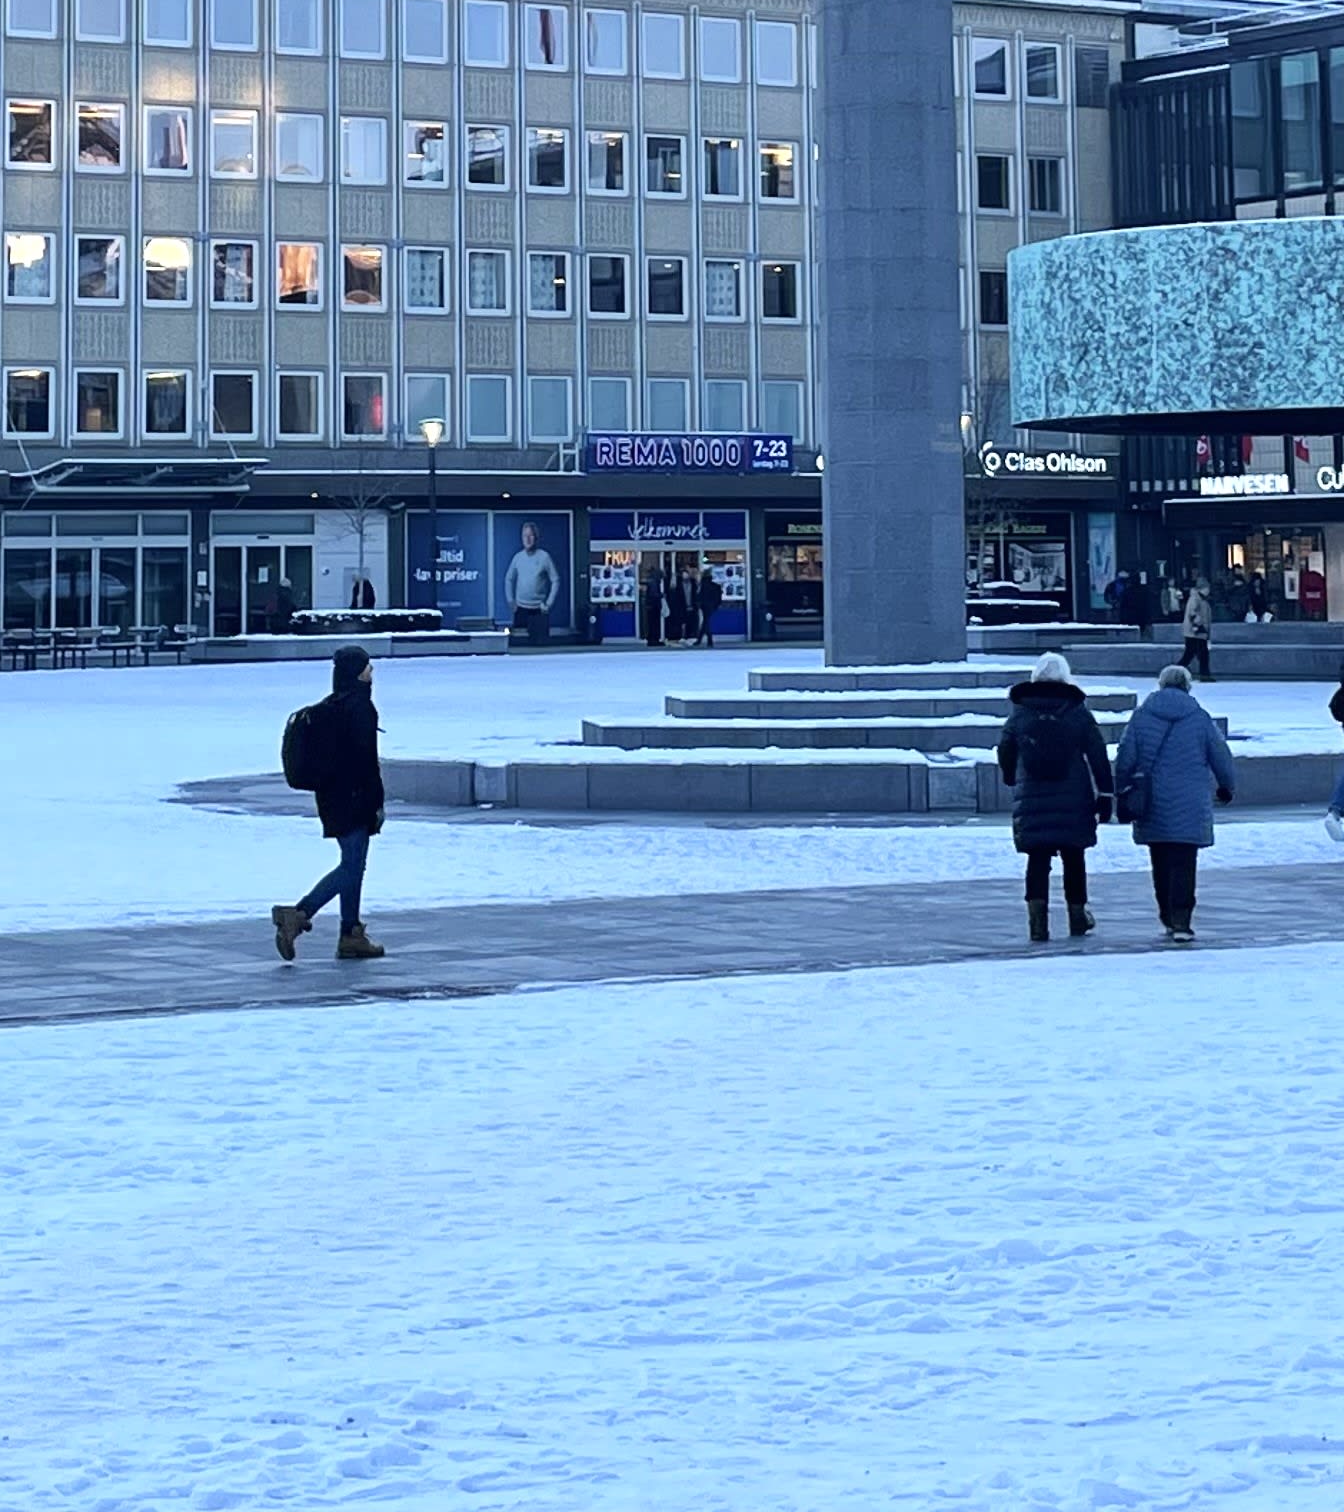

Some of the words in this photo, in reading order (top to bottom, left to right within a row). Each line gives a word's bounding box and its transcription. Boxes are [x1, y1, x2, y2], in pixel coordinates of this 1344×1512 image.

[596, 438, 677, 466] REMA
[681, 438, 740, 467] 1000
[753, 439, 787, 457] 7-23
[1004, 452, 1045, 472] Clas
[1046, 452, 1107, 473] Ohlson
[1200, 473, 1289, 496] NARVESEN
[443, 568, 479, 583] priser
